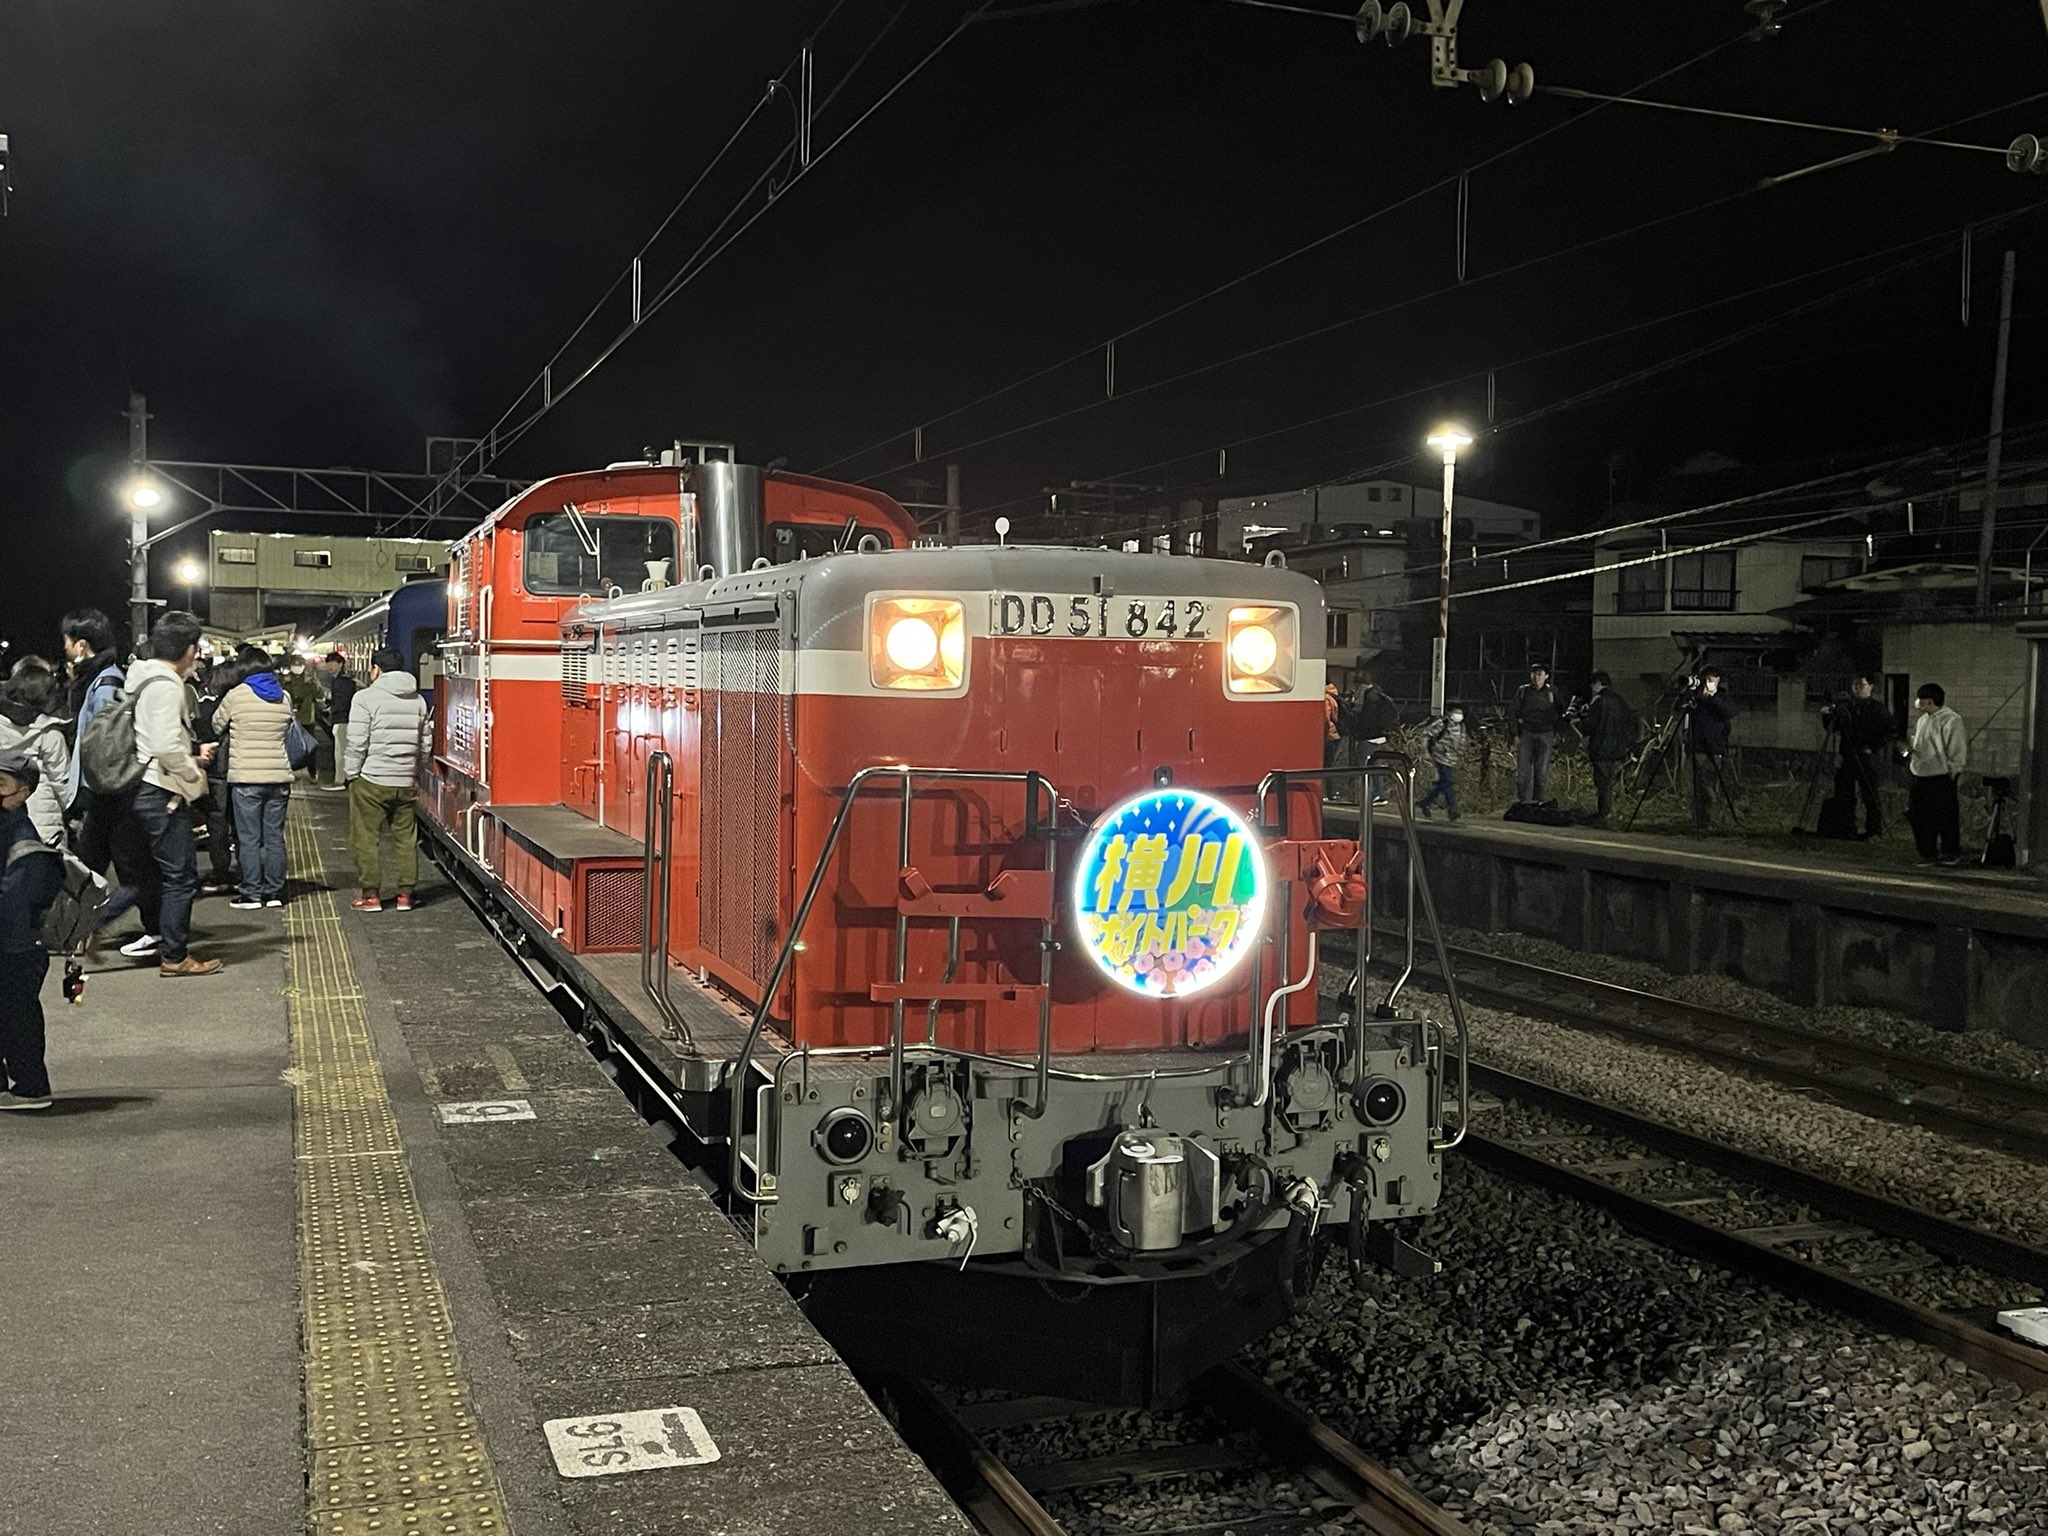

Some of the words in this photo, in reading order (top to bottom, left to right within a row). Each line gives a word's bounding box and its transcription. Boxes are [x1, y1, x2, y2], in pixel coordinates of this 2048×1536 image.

[1125, 599, 1206, 638] 842
[1095, 833, 1243, 913] 横川
[1099, 903, 1240, 955] ナイトパーク
